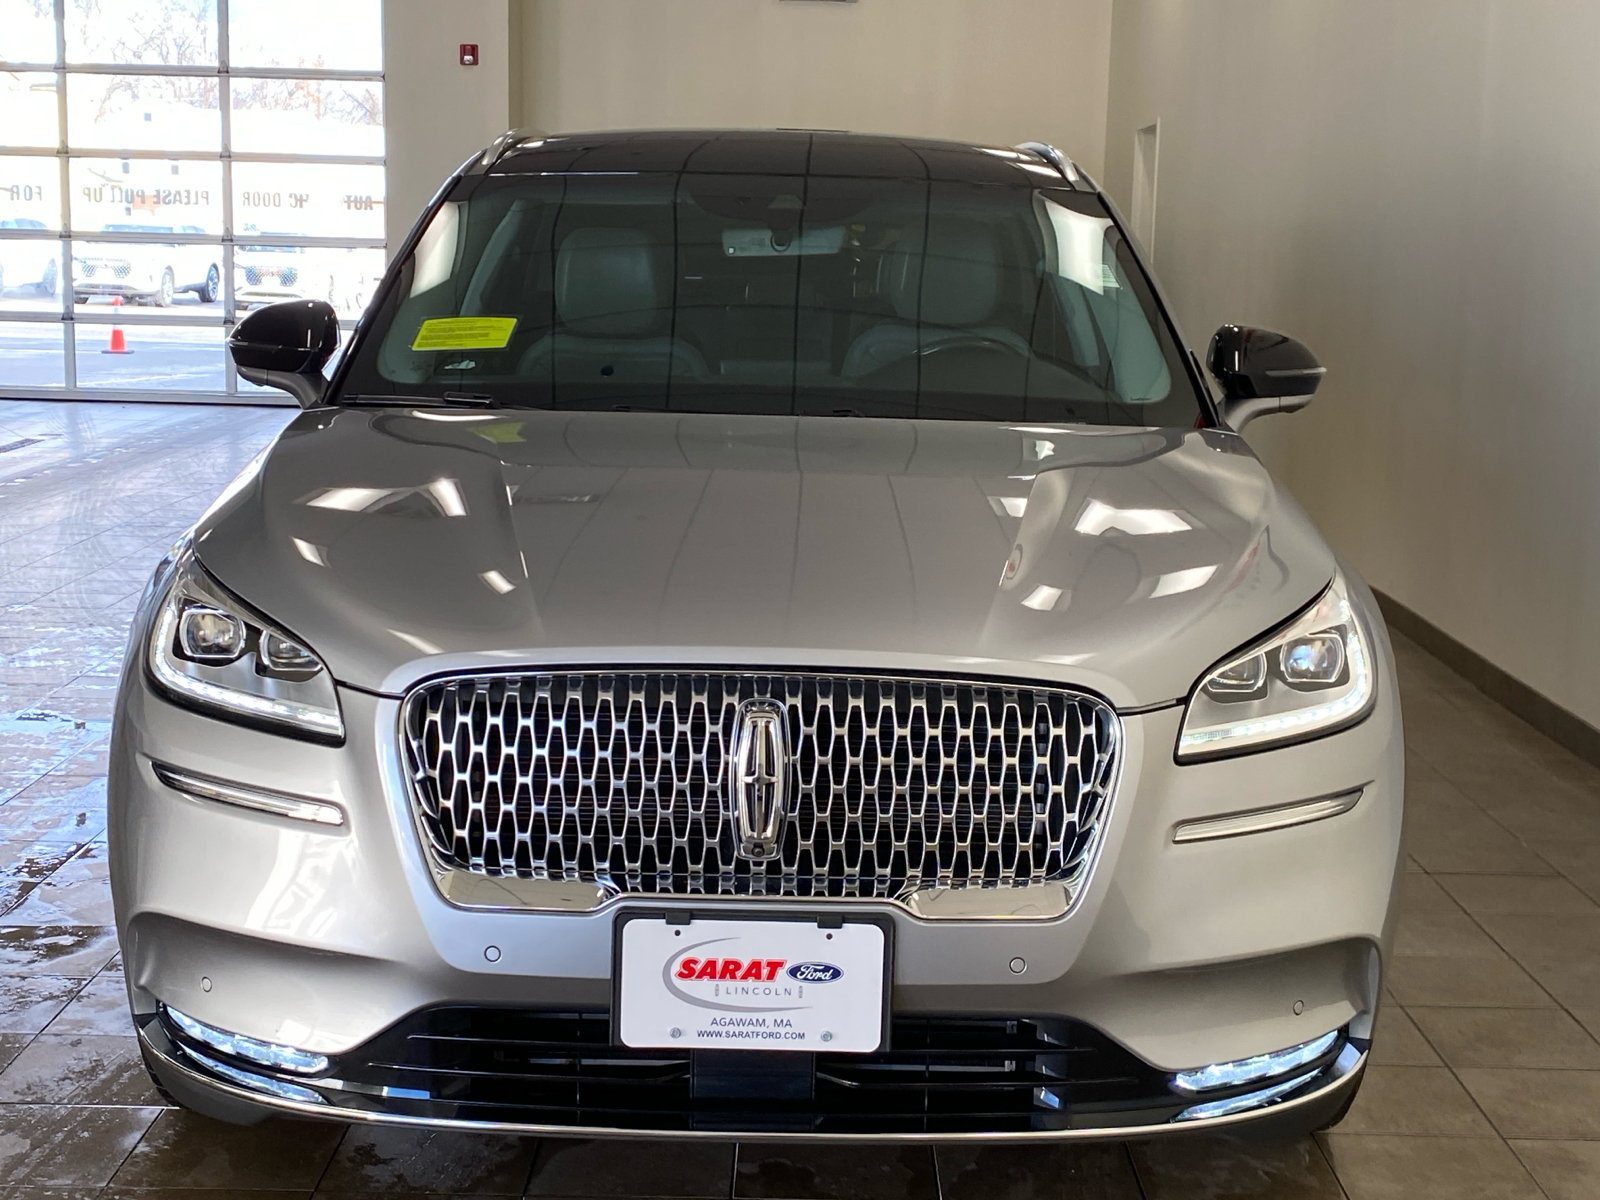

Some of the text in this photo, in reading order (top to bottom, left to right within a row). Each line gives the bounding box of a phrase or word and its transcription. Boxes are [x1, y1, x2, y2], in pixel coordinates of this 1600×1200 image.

[675, 956, 834, 982] SARAT Ford
[726, 986, 792, 996] LINCOLN
[710, 1017, 793, 1029] AGAWAM, MA
[697, 1030, 806, 1040] WWW.SARATFORD.COM
